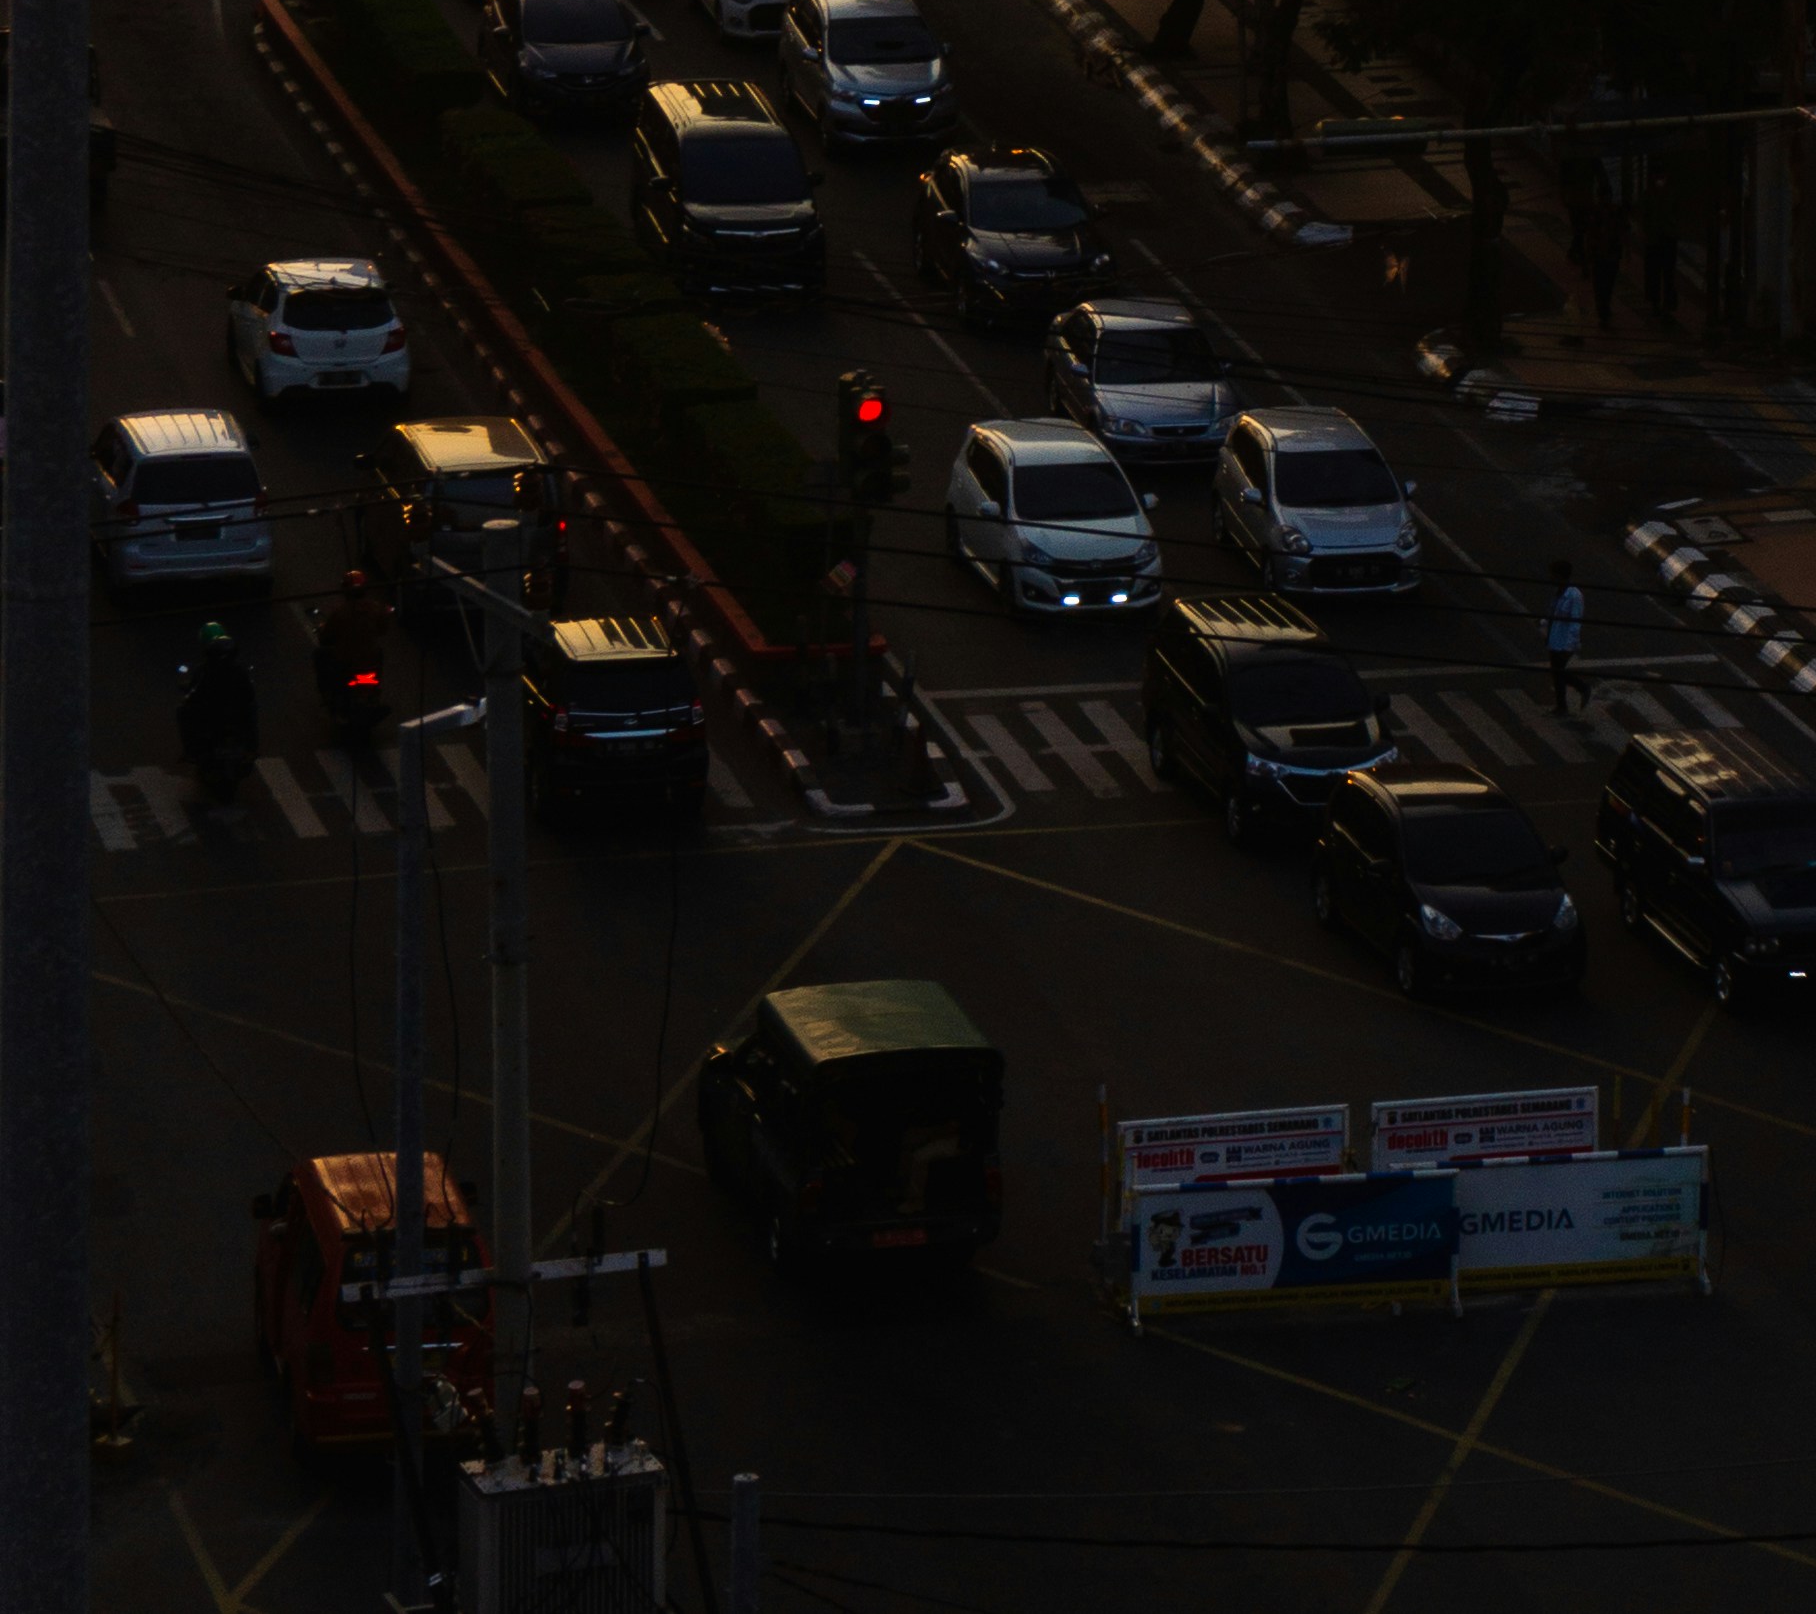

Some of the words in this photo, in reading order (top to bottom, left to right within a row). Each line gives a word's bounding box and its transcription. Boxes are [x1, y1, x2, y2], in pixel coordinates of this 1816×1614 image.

[1401, 1107, 1453, 1123] SATLANTAS
[1520, 1098, 1573, 1115] SEMARANG
[1146, 1127, 1199, 1143] SATLANTAS
[1267, 1118, 1319, 1134] SEMARANG
[1387, 1129, 1448, 1150] decolith
[1496, 1122, 1539, 1135] WARNA
[1541, 1119, 1584, 1132] AGUNG
[1244, 1141, 1286, 1155] WARNA
[1288, 1138, 1331, 1151] AGUNG
[1347, 1221, 1442, 1244] GMEDIA
[1459, 1207, 1575, 1236] GMEDIA
[1181, 1244, 1269, 1268] BERSATU
[1151, 1265, 1238, 1282] KESELAMATAN
[1240, 1263, 1267, 1276] NO.1
